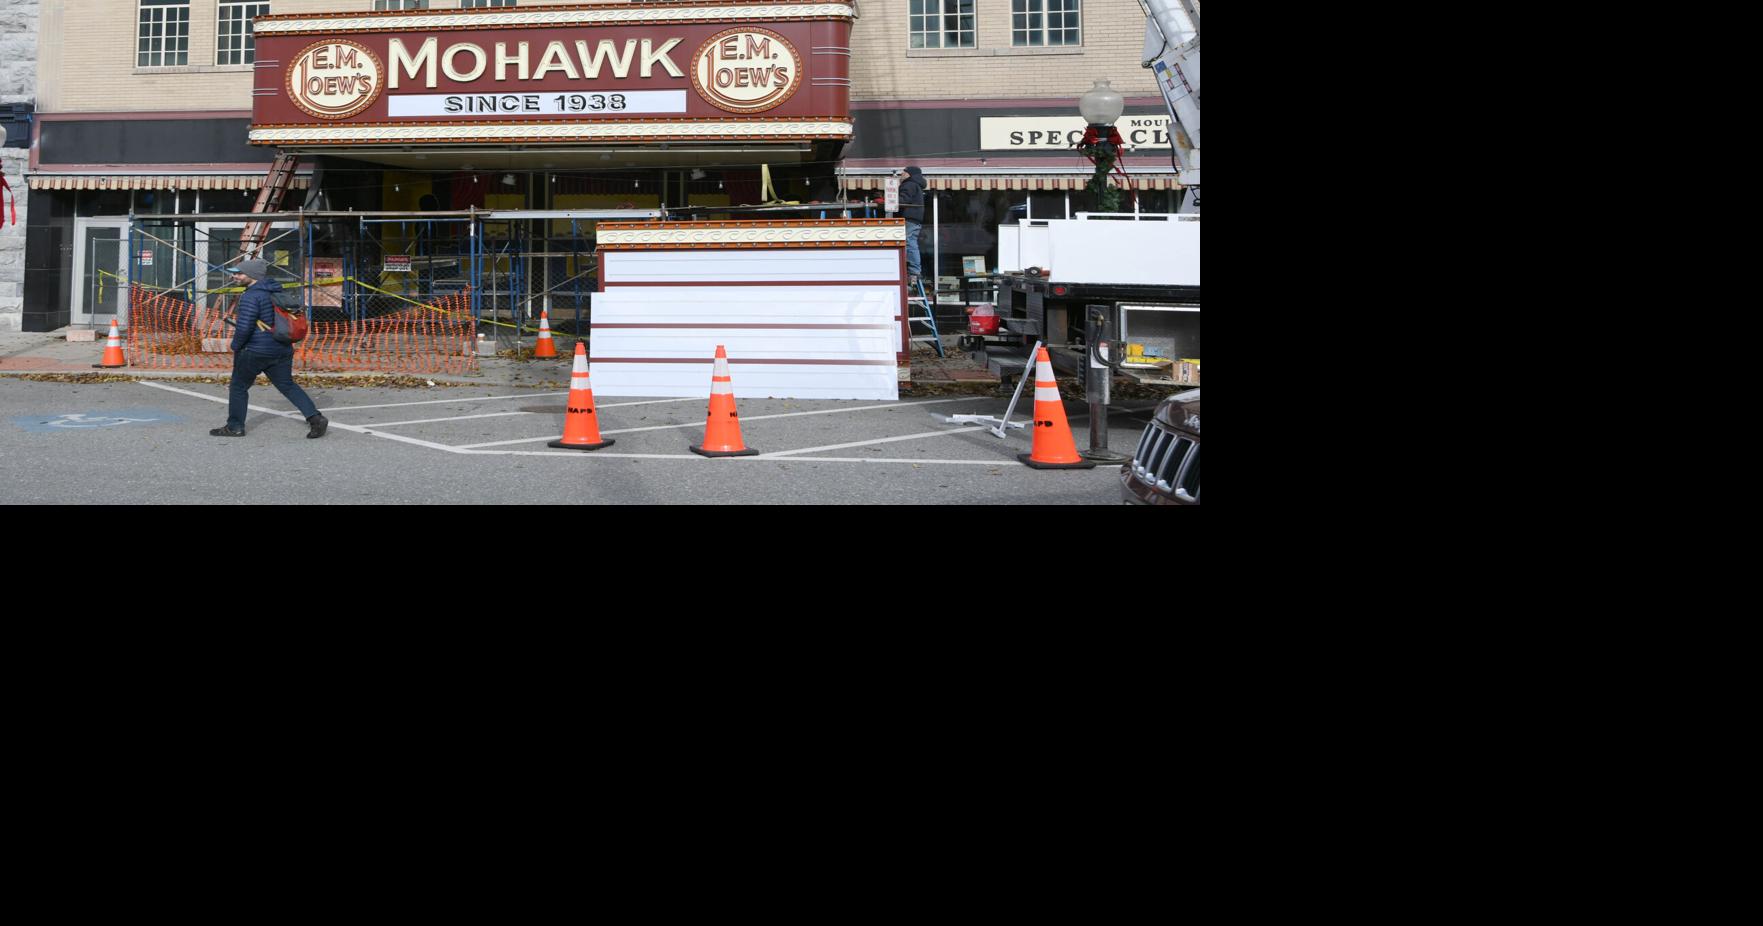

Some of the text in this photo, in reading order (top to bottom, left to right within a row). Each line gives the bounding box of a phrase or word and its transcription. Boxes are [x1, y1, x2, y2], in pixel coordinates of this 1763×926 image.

[312, 46, 363, 70] E.M.
[719, 34, 778, 60] E.M.
[387, 36, 686, 89] MOHAWK
[444, 93, 627, 113] SINCE 1938
